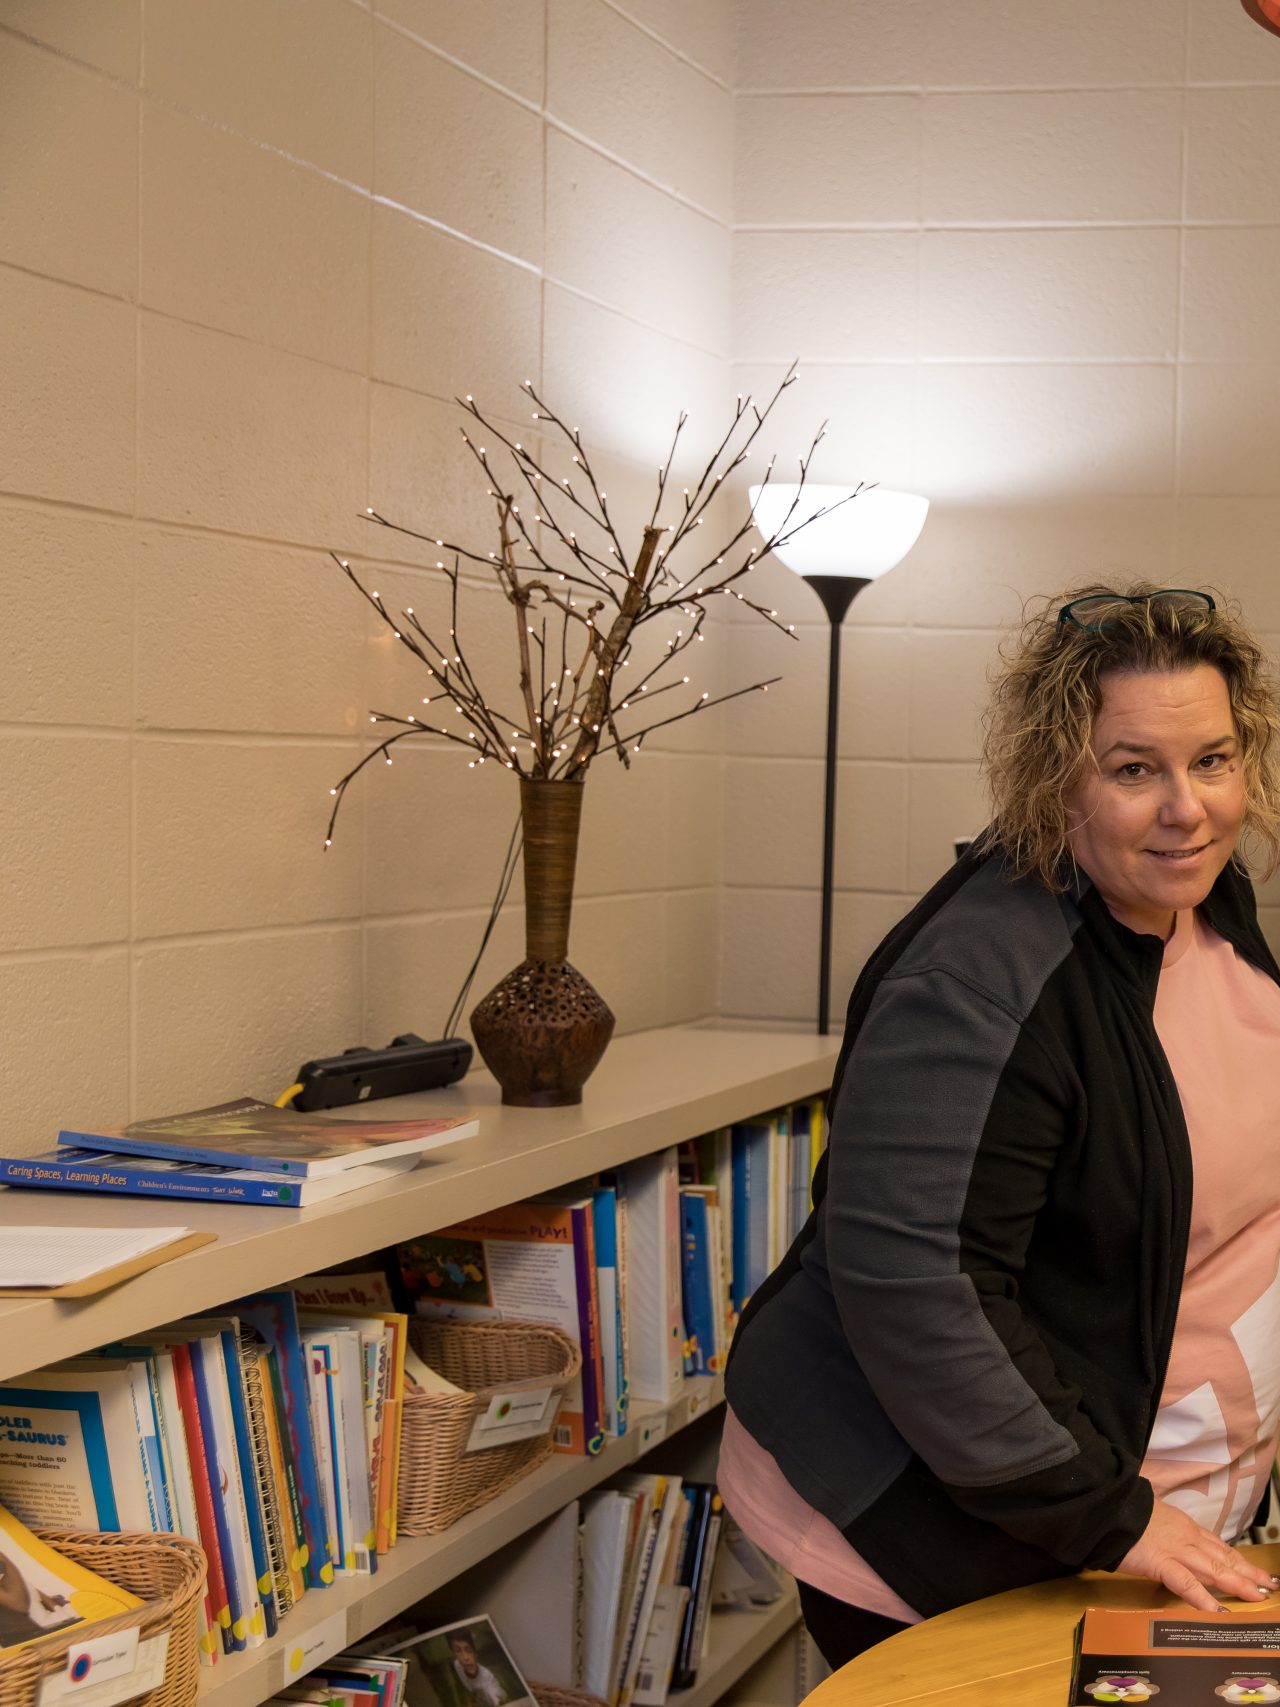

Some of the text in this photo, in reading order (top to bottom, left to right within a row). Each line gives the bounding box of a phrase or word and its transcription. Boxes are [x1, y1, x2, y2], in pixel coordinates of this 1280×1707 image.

[8, 1164, 33, 1179] Caring
[34, 1167, 64, 1181] Spaces,
[66, 1170, 100, 1185] Learning
[101, 1173, 127, 1186] Places
[137, 1180, 168, 1189] Children's
[168, 1183, 210, 1193] Environments
[529, 1226, 568, 1239] PLAY!
